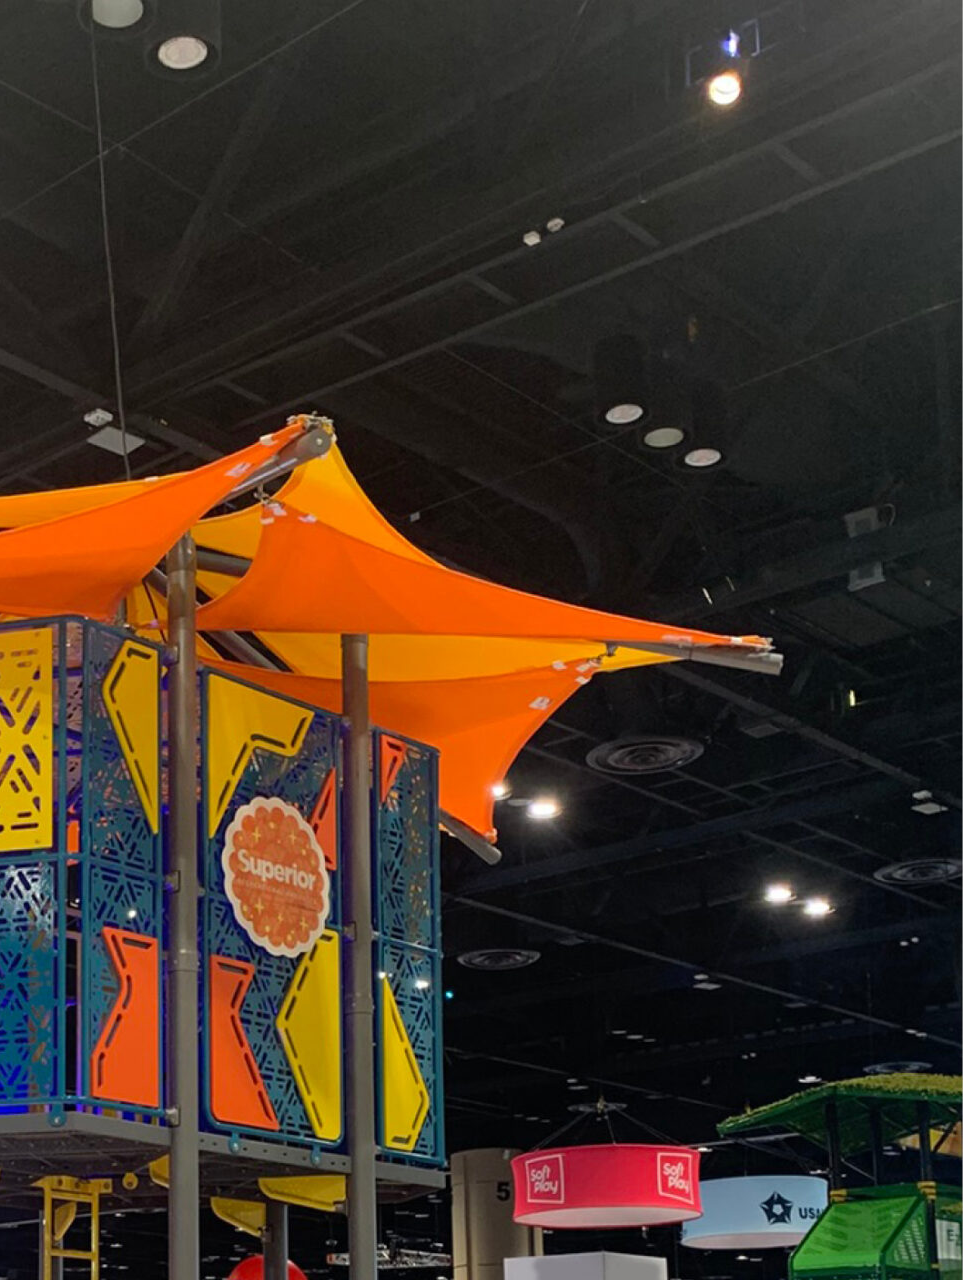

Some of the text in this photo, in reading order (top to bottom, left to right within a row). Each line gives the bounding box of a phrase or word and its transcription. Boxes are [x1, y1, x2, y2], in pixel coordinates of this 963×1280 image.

[238, 849, 317, 890] Superior
[530, 1164, 550, 1184] Soft
[663, 1162, 684, 1182] Soft
[496, 1182, 510, 1201] 5
